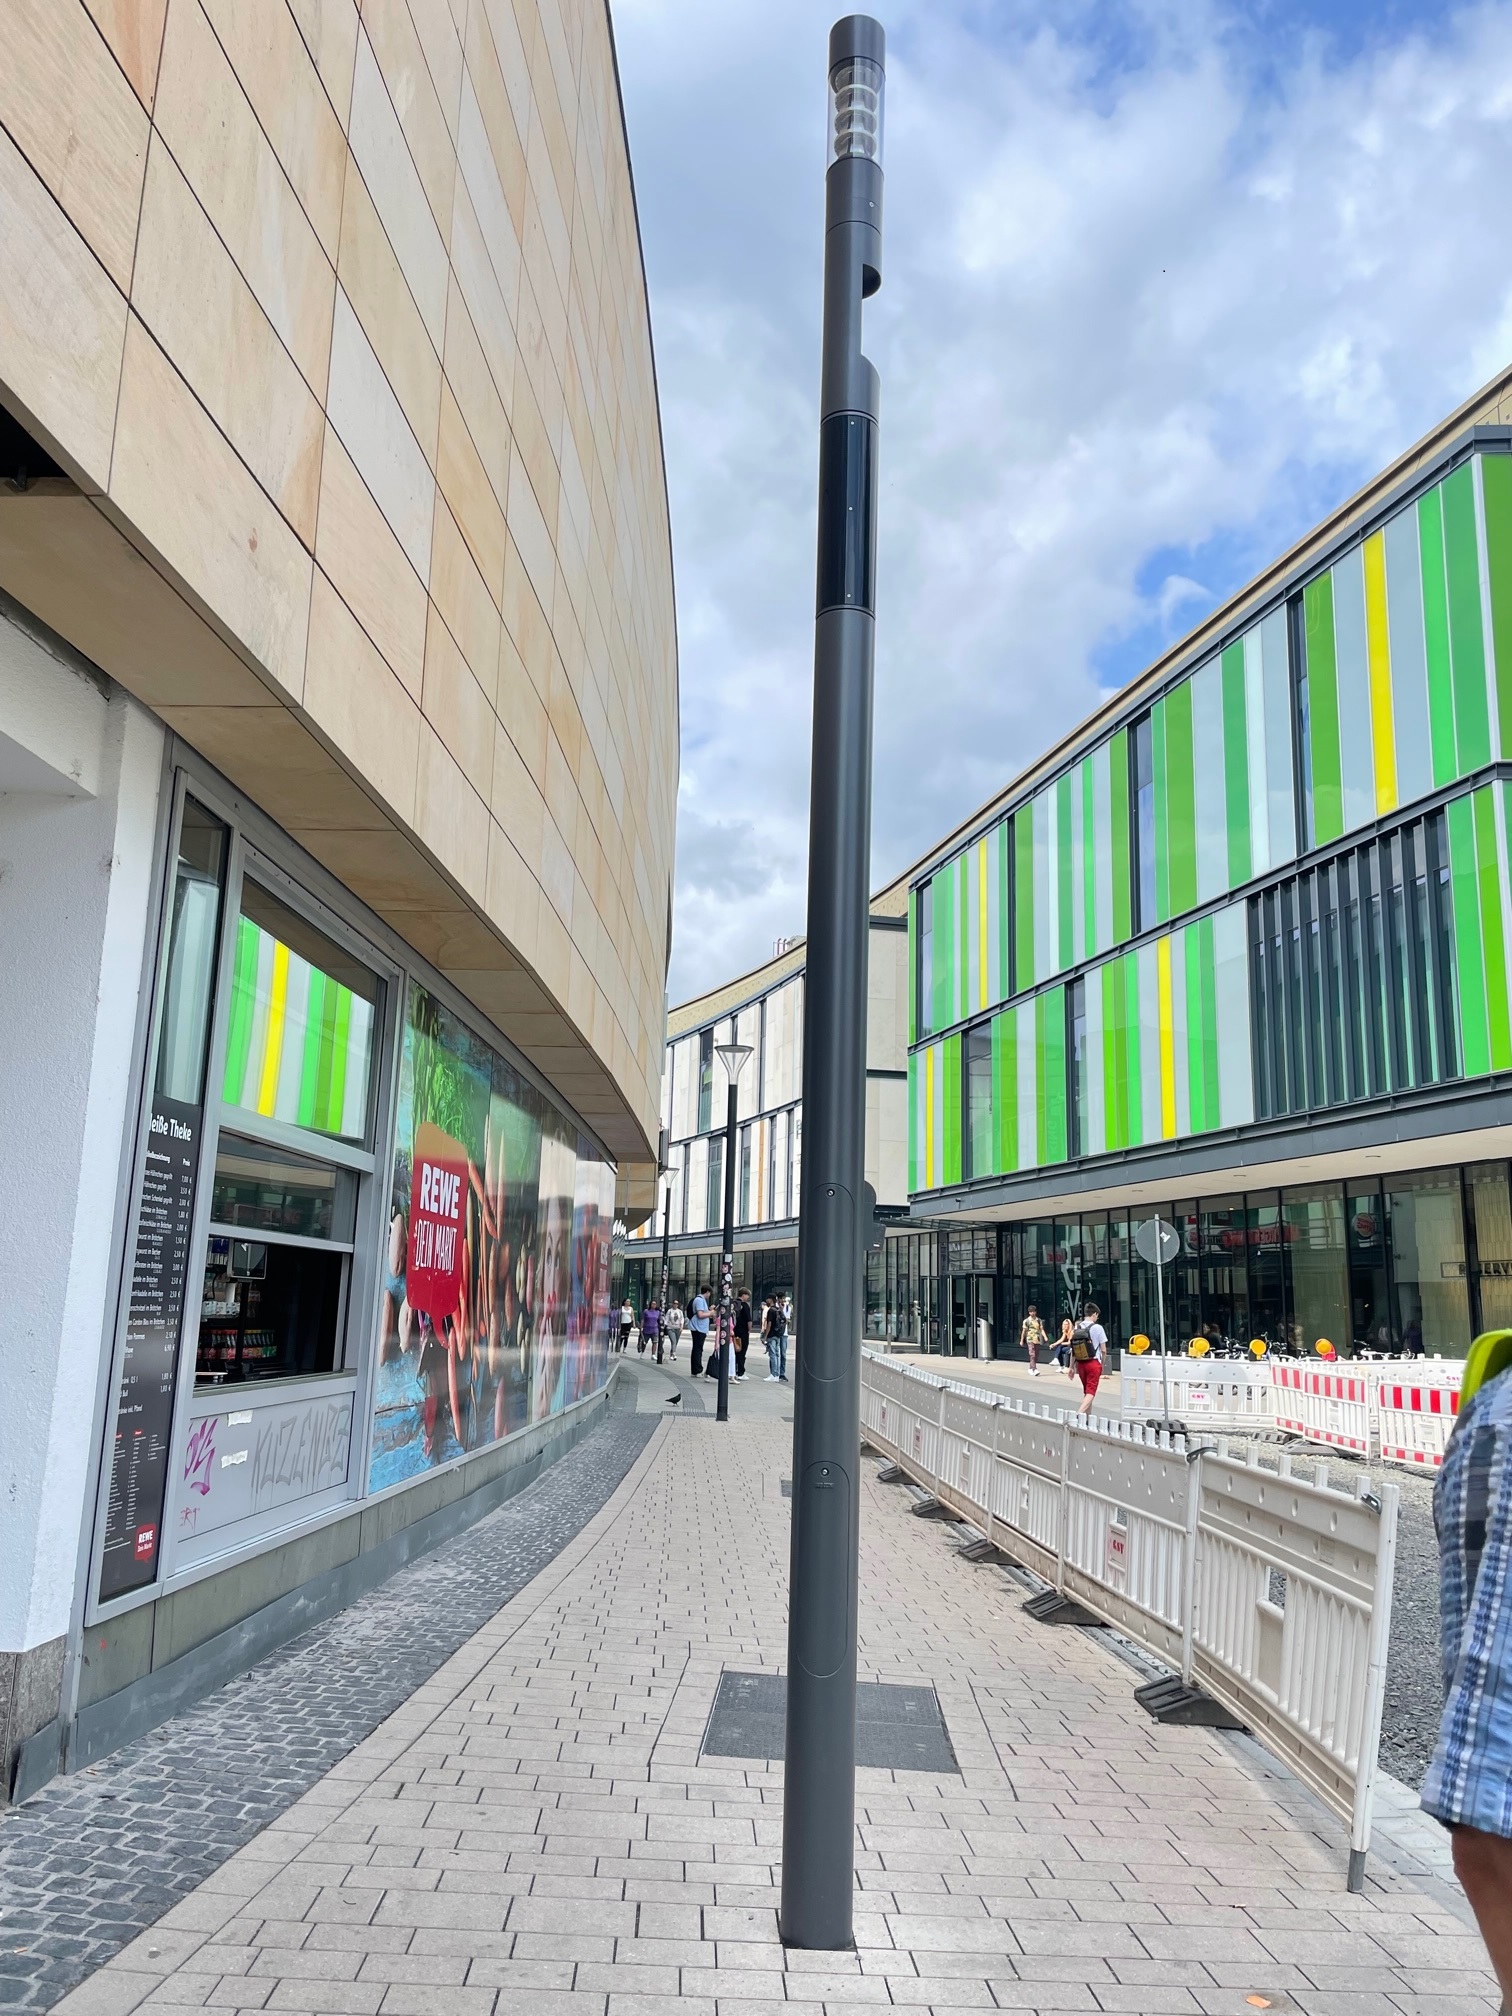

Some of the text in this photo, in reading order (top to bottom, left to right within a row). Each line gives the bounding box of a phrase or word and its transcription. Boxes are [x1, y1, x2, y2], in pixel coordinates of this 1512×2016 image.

[170, 1118, 192, 1142] Theke
[419, 1162, 461, 1220] REWE
[415, 1218, 457, 1272] DEIN MARKT
[138, 1530, 154, 1544] REWE
[144, 1542, 152, 1551] Markt
